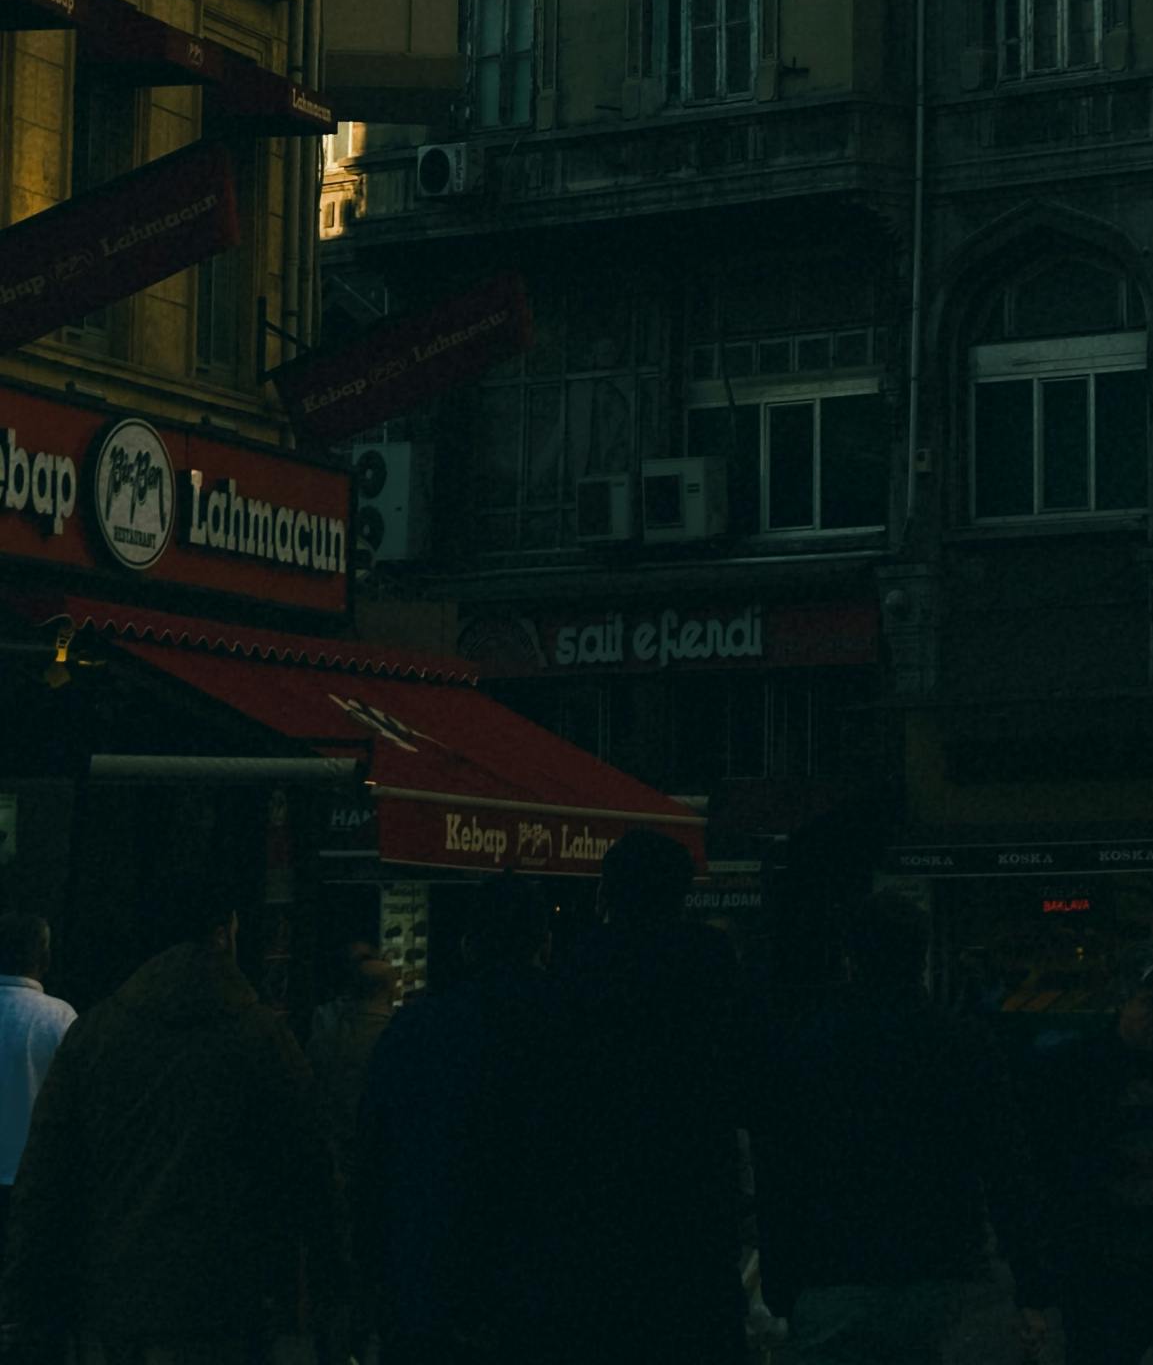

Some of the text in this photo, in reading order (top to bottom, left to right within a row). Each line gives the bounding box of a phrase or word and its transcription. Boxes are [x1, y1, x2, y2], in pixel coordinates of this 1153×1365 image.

[301, 376, 368, 415] Kebap
[0, 427, 77, 537] bap
[189, 469, 348, 574] Lahmacun
[633, 604, 764, 669] efendi
[445, 813, 507, 863] Kebap
[899, 854, 955, 868] KOSKA
[997, 852, 1054, 866] KOSKA
[721, 893, 762, 908] ADAM
[1042, 898, 1091, 913] BAKLAVA
